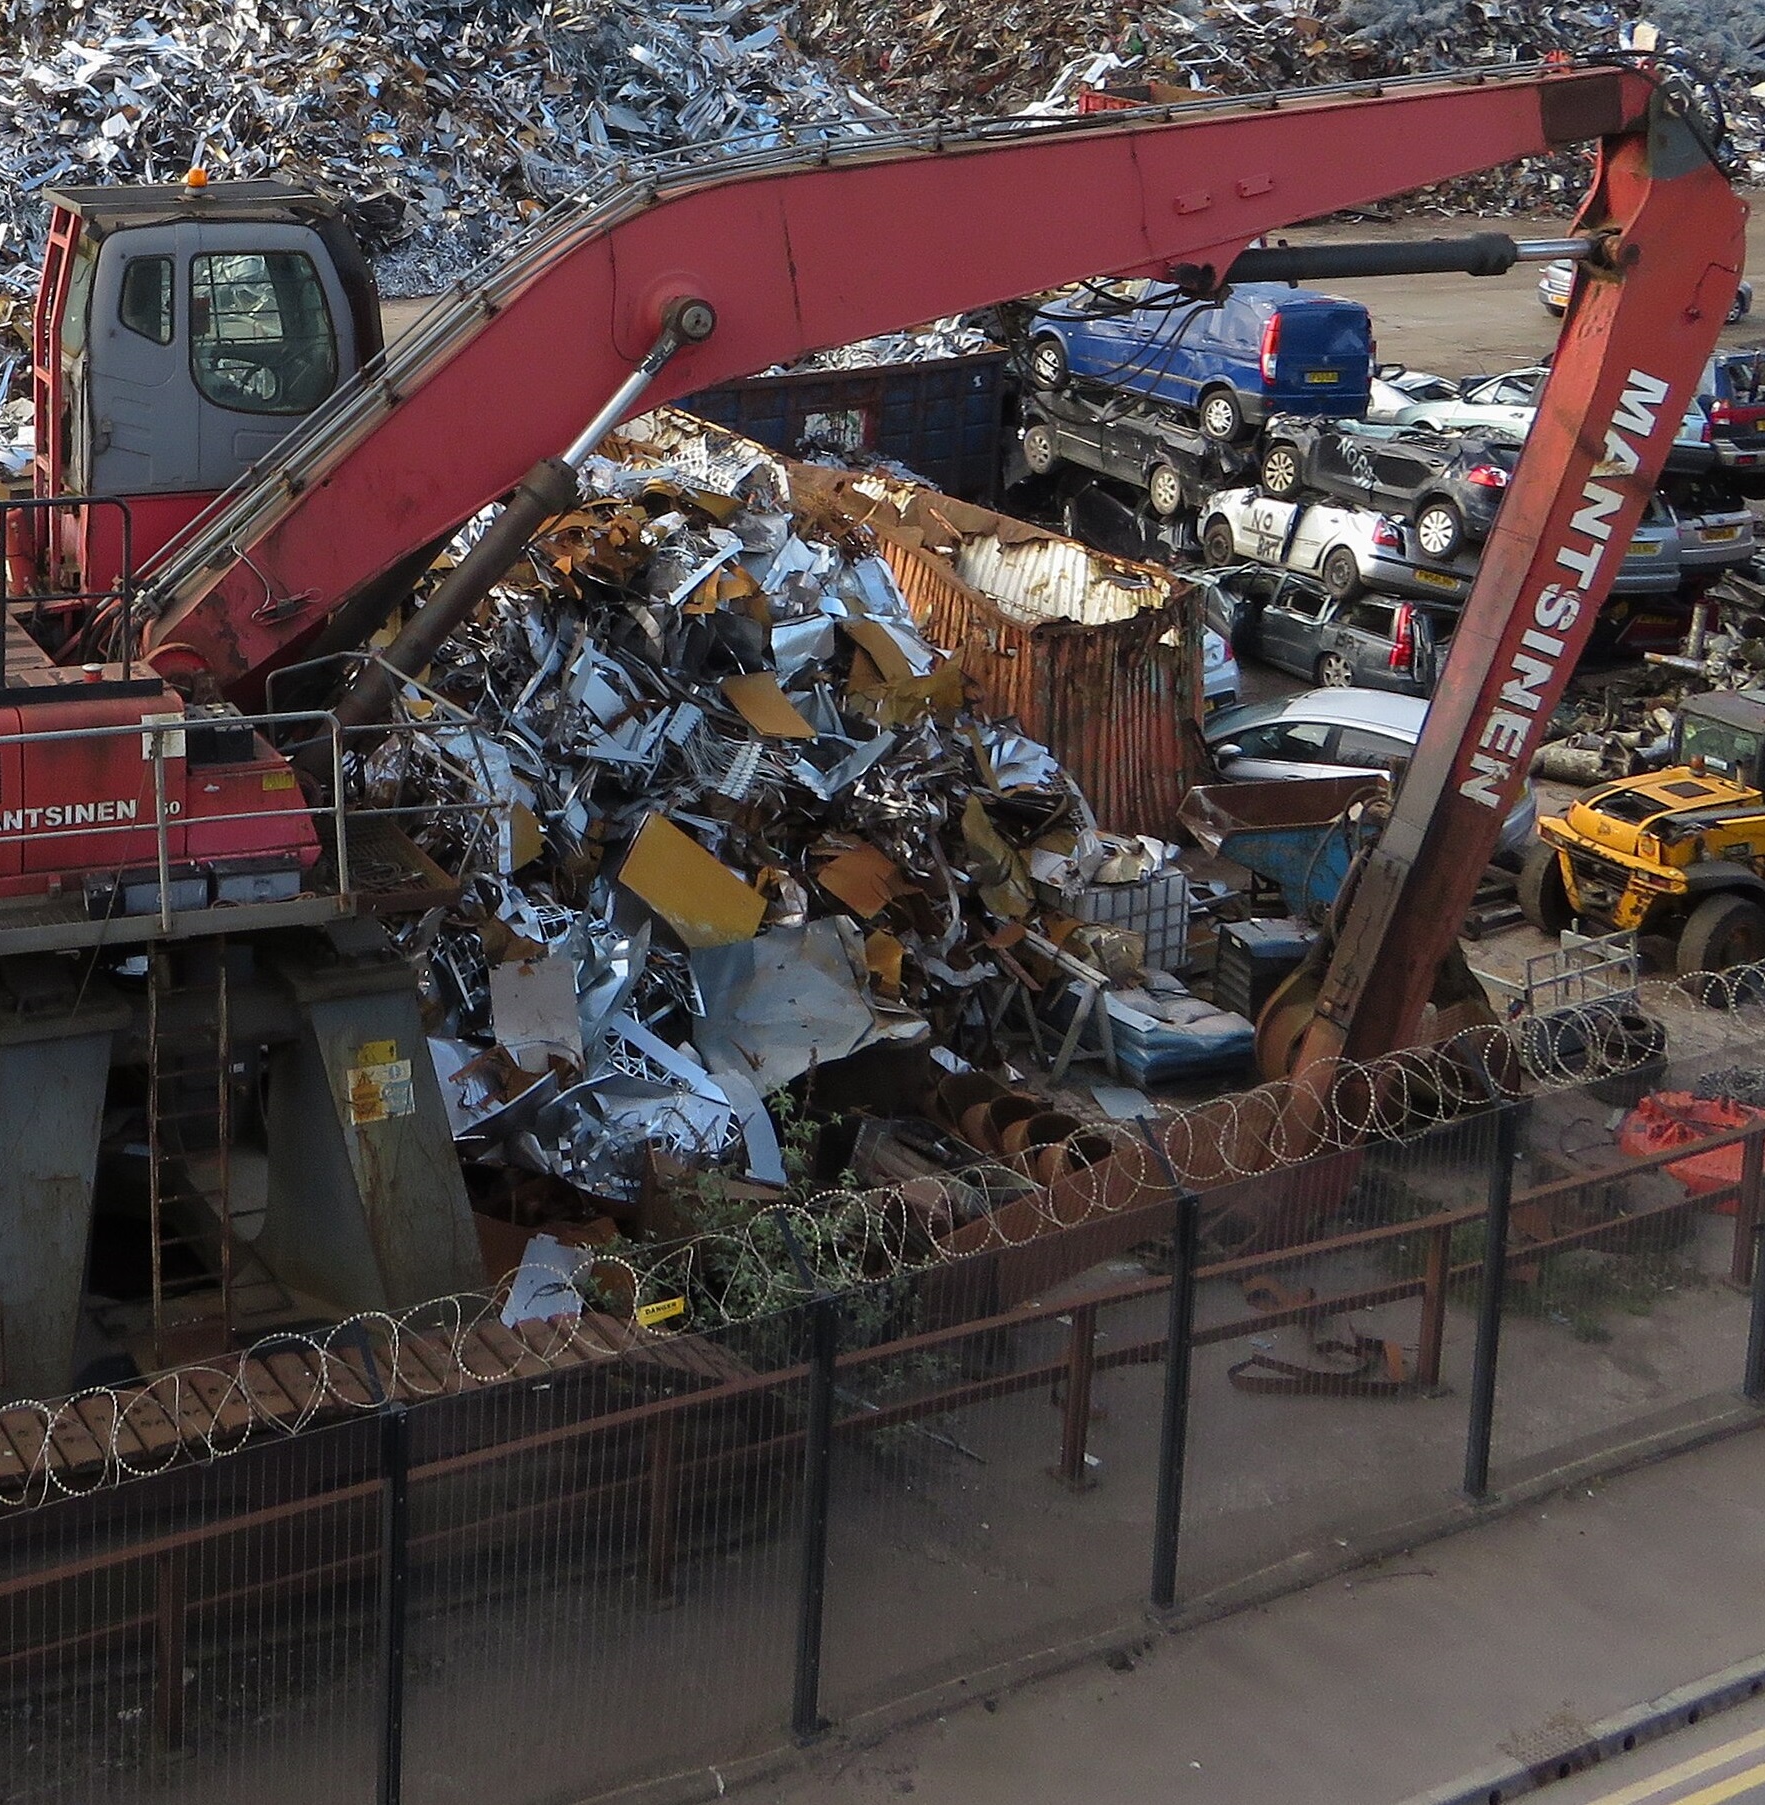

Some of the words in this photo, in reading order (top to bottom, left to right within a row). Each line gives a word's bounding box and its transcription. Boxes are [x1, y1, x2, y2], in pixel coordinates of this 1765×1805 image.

[1251, 509, 1273, 533] NO
[1458, 368, 1670, 809] MANTSINEN
[645, 1302, 677, 1315] DANGER
